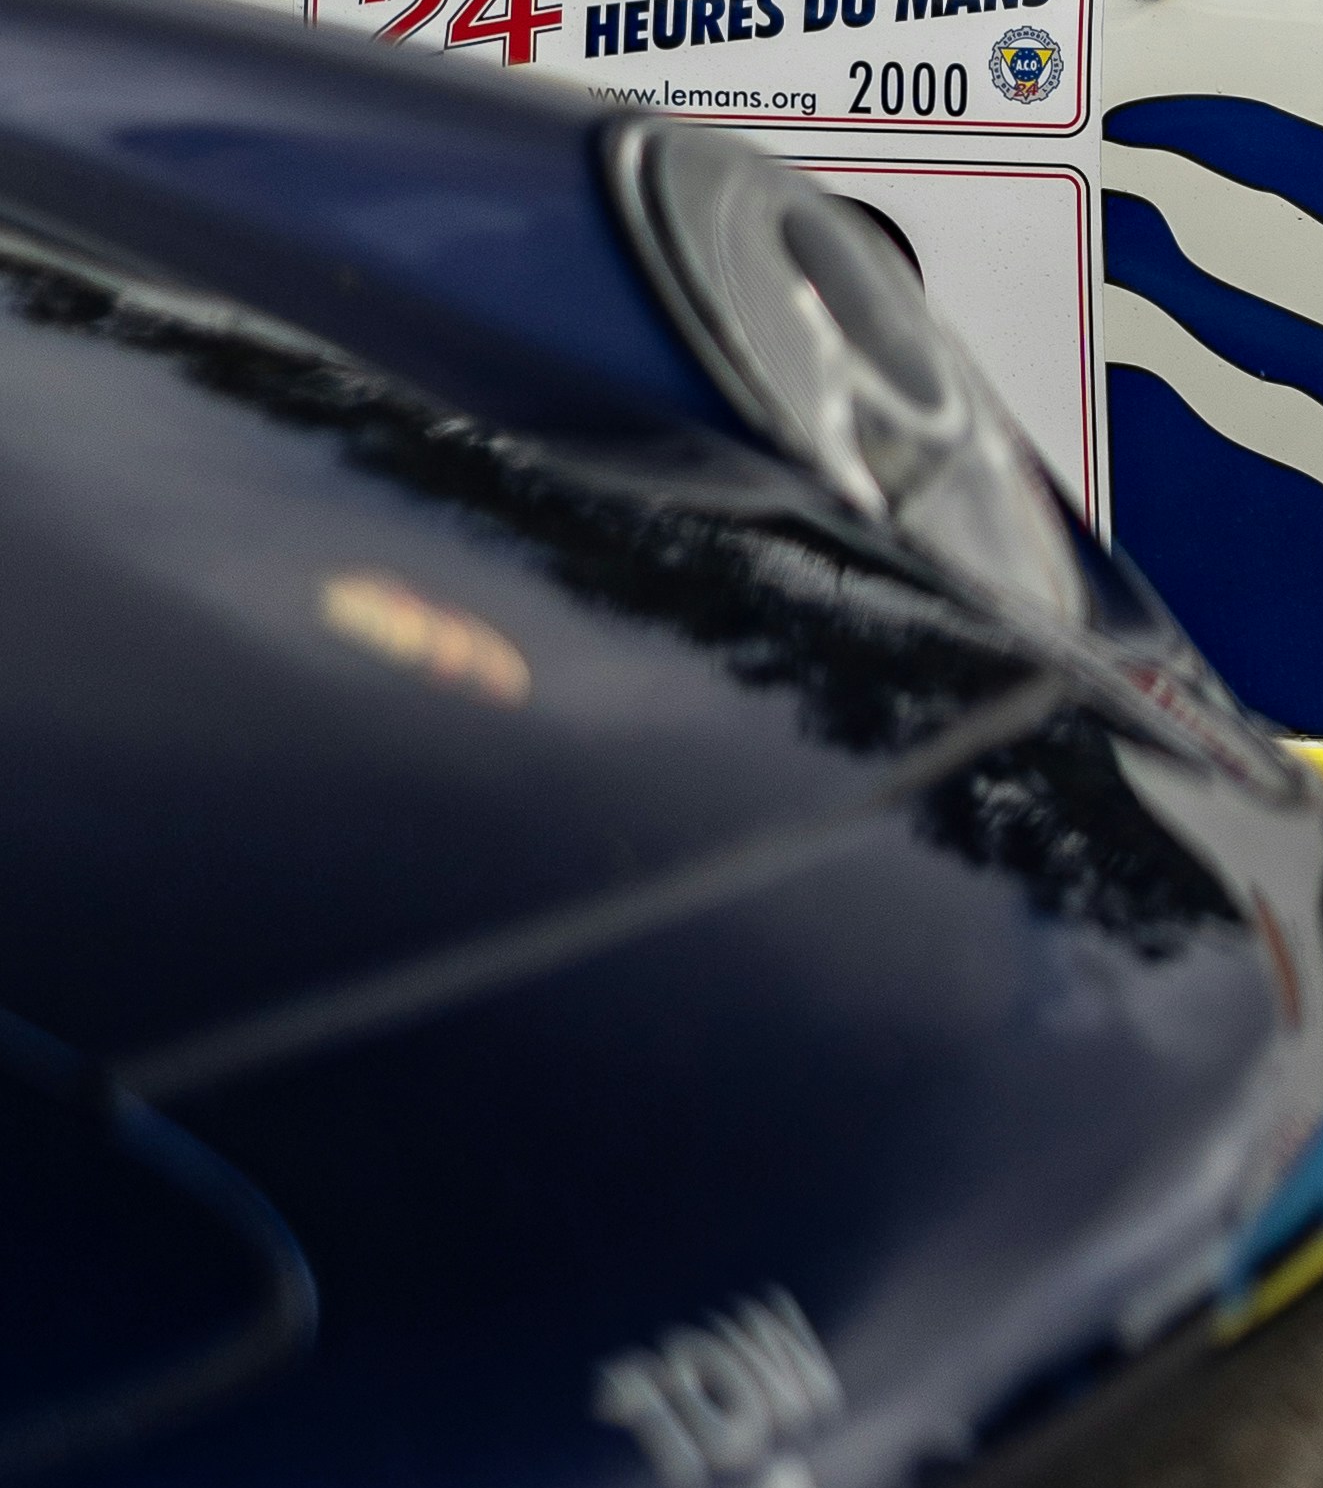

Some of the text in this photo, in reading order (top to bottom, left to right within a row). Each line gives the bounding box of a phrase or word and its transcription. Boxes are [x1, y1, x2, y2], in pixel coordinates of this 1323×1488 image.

[588, 80, 816, 116] www.lemans.org
[848, 60, 968, 117] 2000
[1013, 82, 1039, 97] 24
